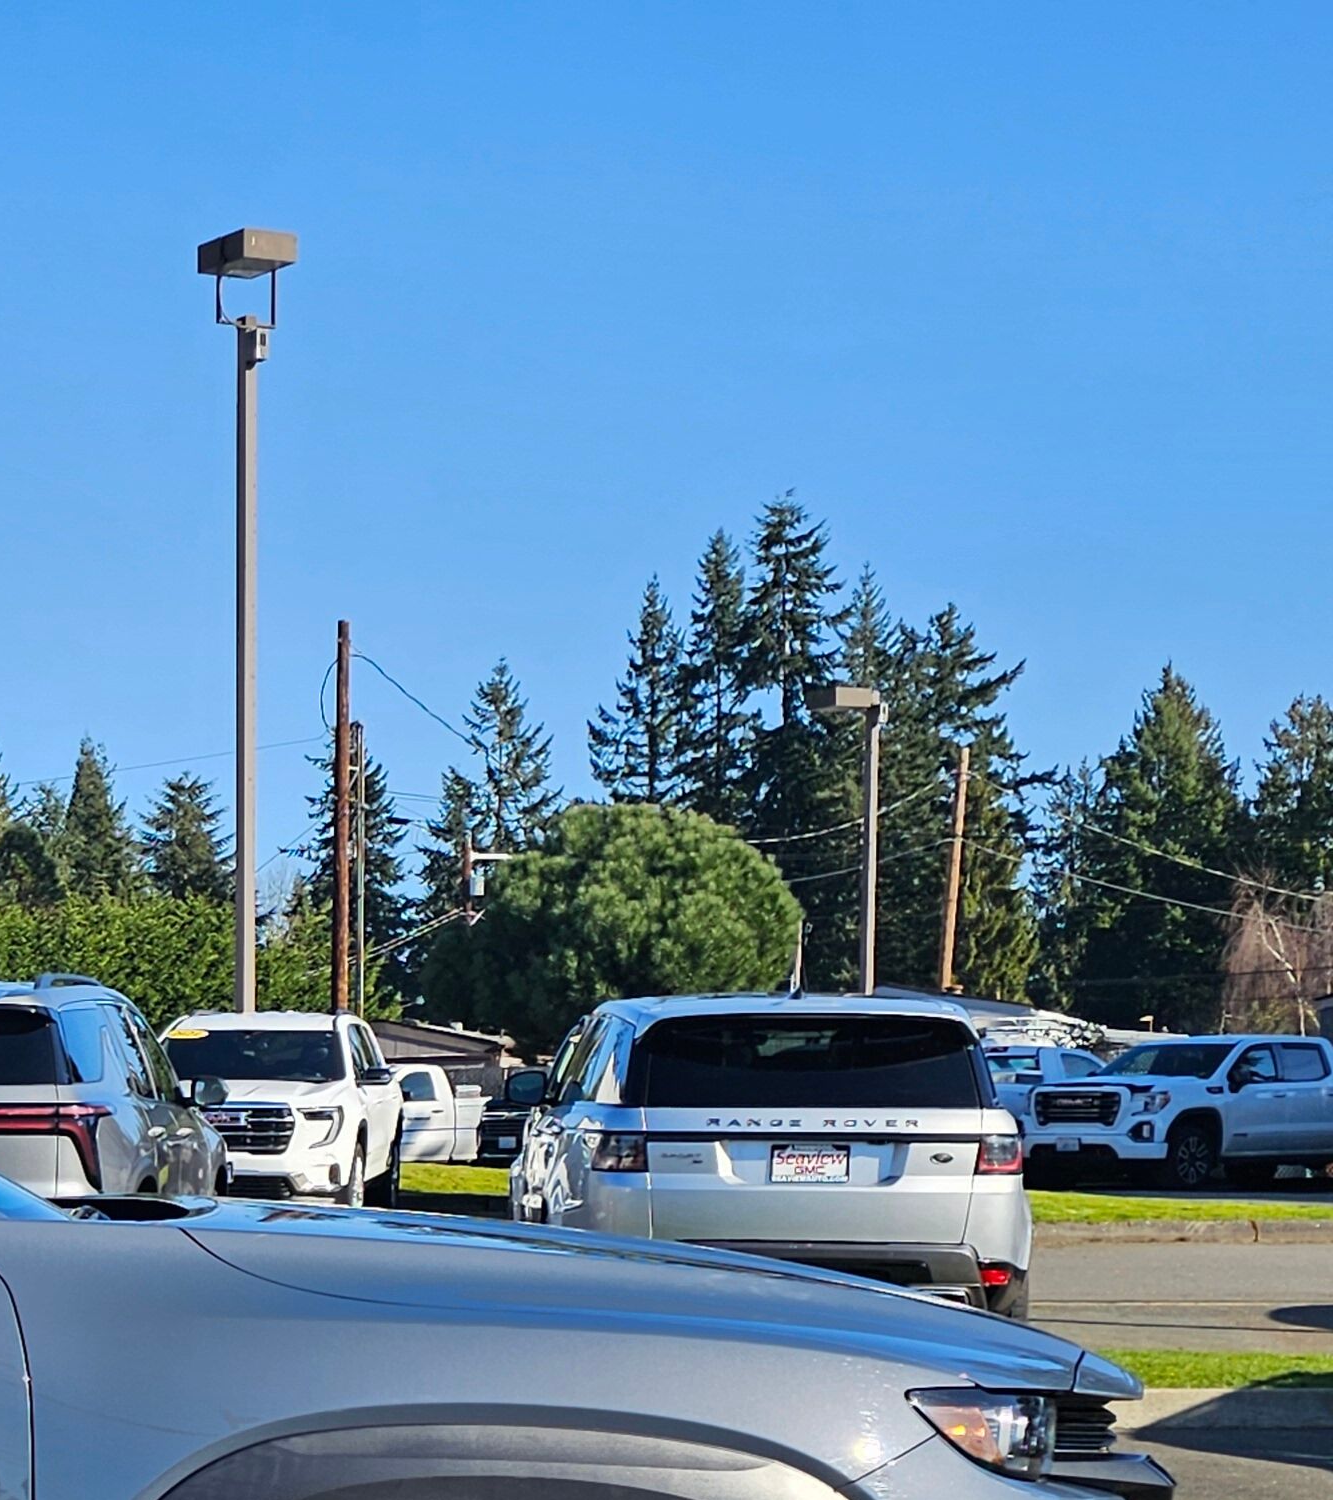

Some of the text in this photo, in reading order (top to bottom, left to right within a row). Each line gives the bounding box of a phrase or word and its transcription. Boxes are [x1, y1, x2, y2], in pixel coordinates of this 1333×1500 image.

[706, 1117, 919, 1129] RANGE ROVER
[775, 1150, 847, 1165] Seaview
[794, 1166, 826, 1174] GMC
